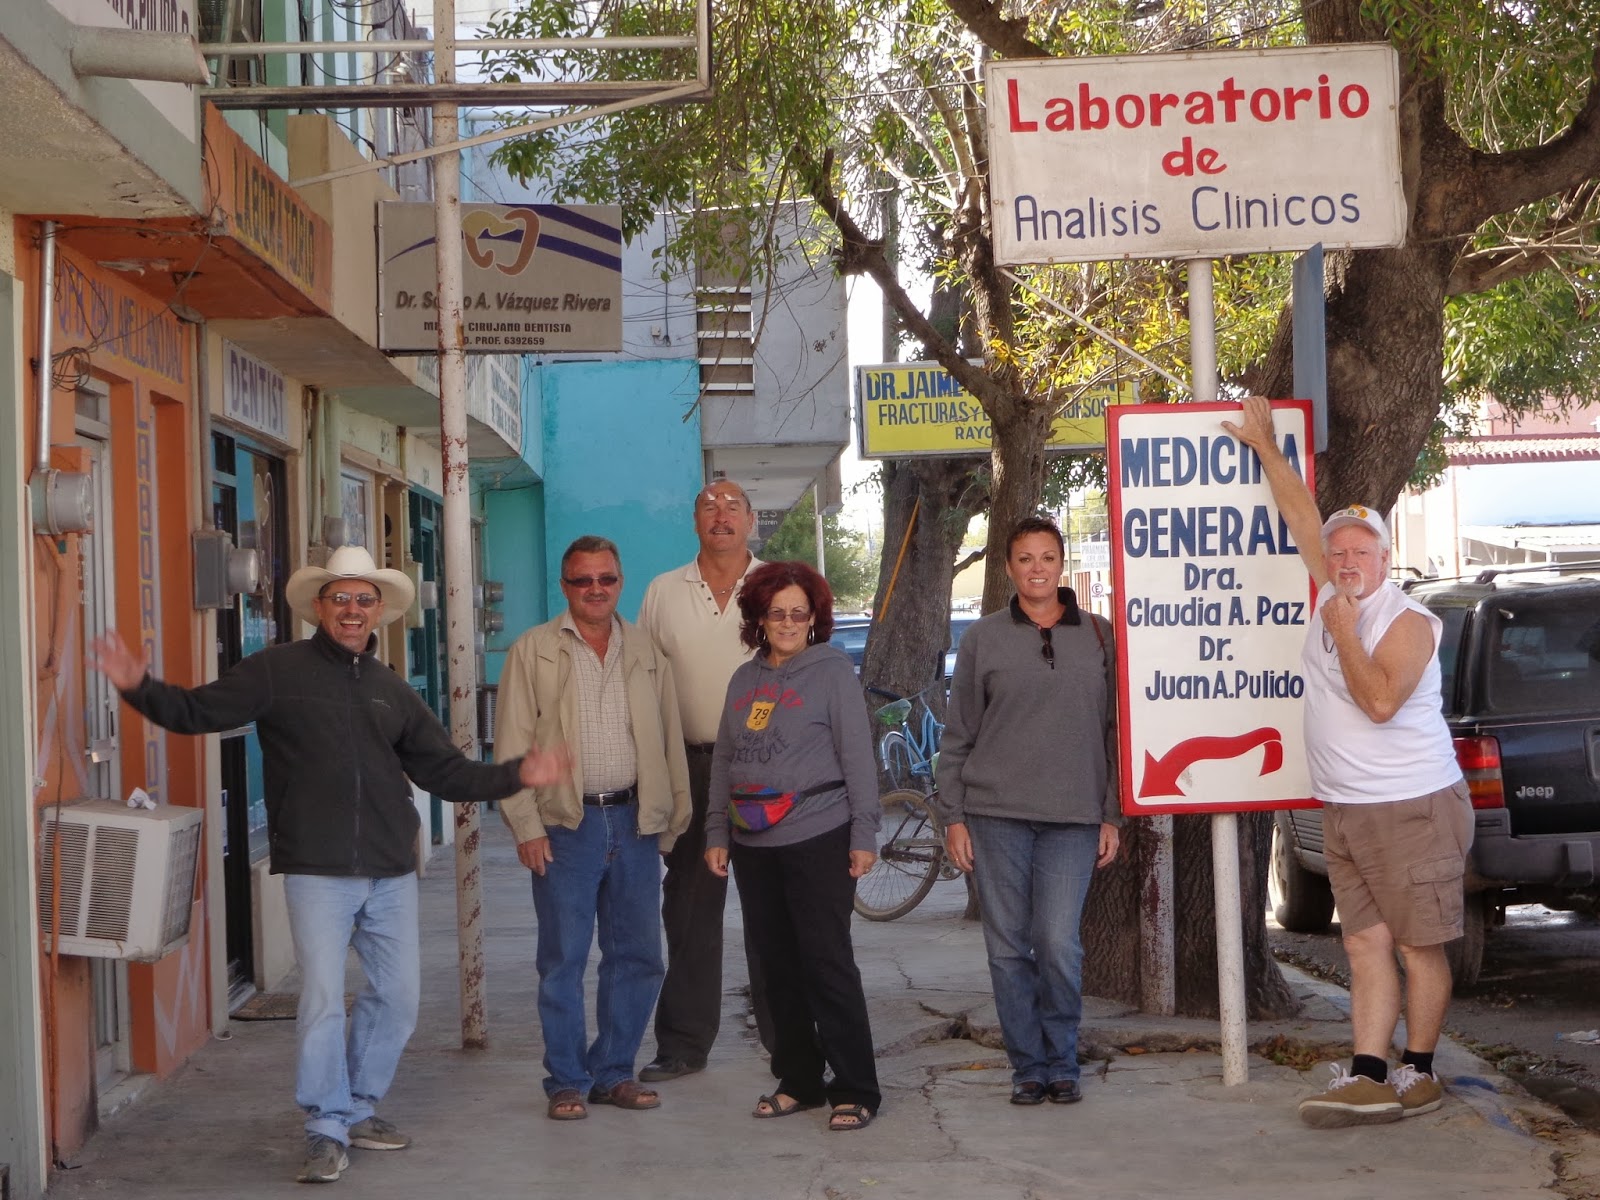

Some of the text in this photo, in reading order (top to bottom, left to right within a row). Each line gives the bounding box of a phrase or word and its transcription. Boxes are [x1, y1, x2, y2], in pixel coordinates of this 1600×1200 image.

[1007, 74, 1370, 133] Laboratorio
[1161, 136, 1228, 177] de
[1014, 186, 1361, 242] Analisis Clinicos
[396, 291, 417, 309] Dr.
[474, 293, 491, 310] A.
[495, 292, 559, 314] Vázquez
[562, 293, 611, 312] Rivera
[468, 322, 572, 333] CIRUJANO DENTISTA
[475, 336, 501, 346] PROF.
[504, 336, 545, 346] 6392659
[230, 349, 284, 434] DENTIST
[878, 401, 969, 426] FRACTURAS
[1123, 505, 1301, 559] GENERAL
[1184, 562, 1243, 591] Dra.
[1126, 595, 1305, 627] Claudia A. Paz
[1199, 635, 1234, 662] Dr.
[753, 708, 770, 720] 79
[1516, 785, 1555, 799] Jeep
